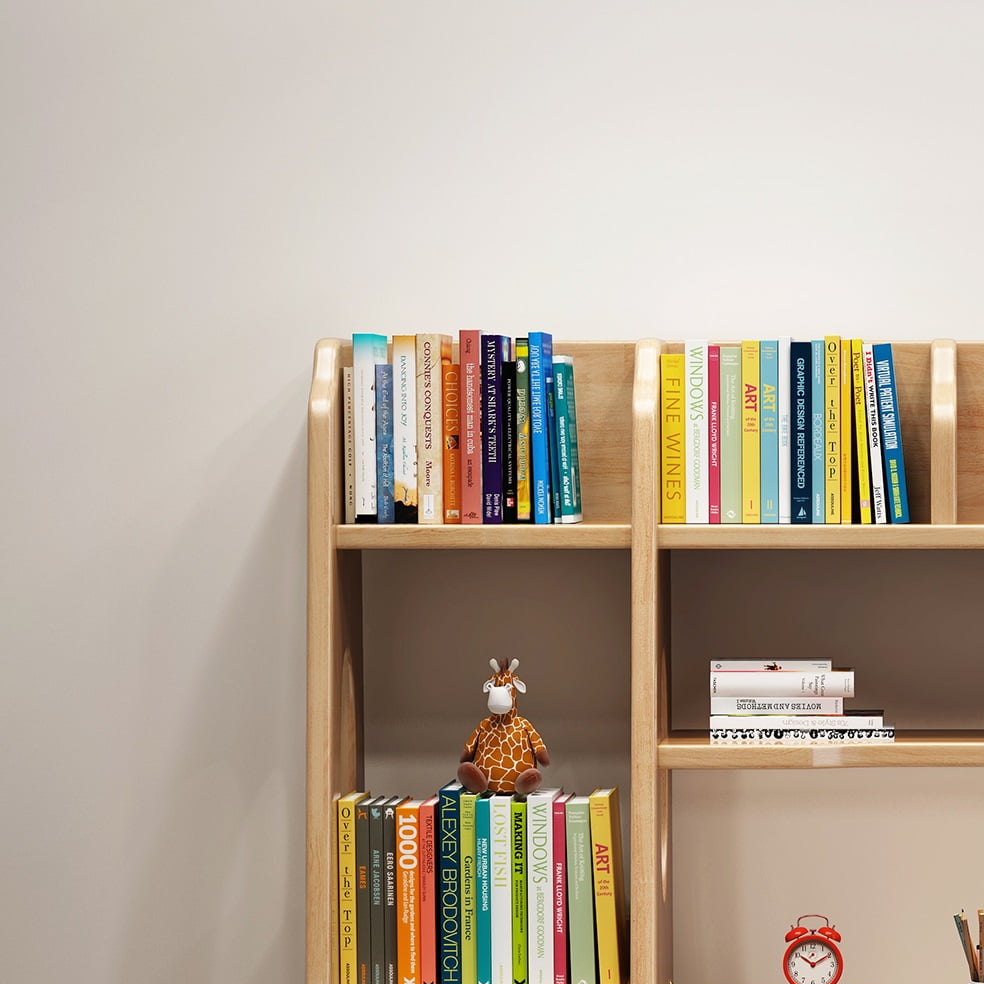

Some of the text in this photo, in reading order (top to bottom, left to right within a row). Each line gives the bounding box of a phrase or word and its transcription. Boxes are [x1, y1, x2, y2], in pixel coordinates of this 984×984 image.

[865, 356, 874, 384] Didn't
[875, 360, 890, 387] VIRTUAL
[422, 341, 433, 488] CONNIE'S CONQUESTS Moore
[444, 370, 458, 432] CHOICES
[466, 362, 475, 454] the handsomest man in cuba
[487, 340, 496, 463] MYSTERY AT SHARK'S TEETH
[745, 383, 758, 412] ART
[763, 383, 776, 412] ART
[868, 385, 876, 408] WRITE
[879, 388, 894, 413] PATIENT
[666, 378, 682, 501] FINE WINES
[796, 358, 805, 489] GRAPHIC DESIGN REFERENCED
[813, 413, 823, 460] BORDEAUX
[881, 413, 898, 450] SIMULATION
[341, 807, 352, 852] Over
[425, 815, 434, 874] TEXTILE DESIGNERS
[493, 803, 508, 888] LOST FISH
[514, 812, 523, 874] MAKING IT
[532, 802, 548, 884] WINDOWS
[372, 849, 380, 868] ARNE
[386, 852, 394, 870] EERO
[398, 814, 418, 870] 1000
[408, 904, 416, 922] gardens
[595, 843, 610, 874] ART
[342, 866, 351, 898] the
[372, 869, 380, 906] JACOBSEN
[386, 872, 394, 906] SAARINEN
[442, 795, 458, 981] ALEXEY BRODOVITCH
[464, 856, 473, 941] Gardens in France
[555, 862, 564, 934] FRANK LLOYD WRIGHT
[536, 892, 545, 923] BERGDORF
[342, 910, 352, 948] Top
[536, 924, 545, 959] GOODMAN
